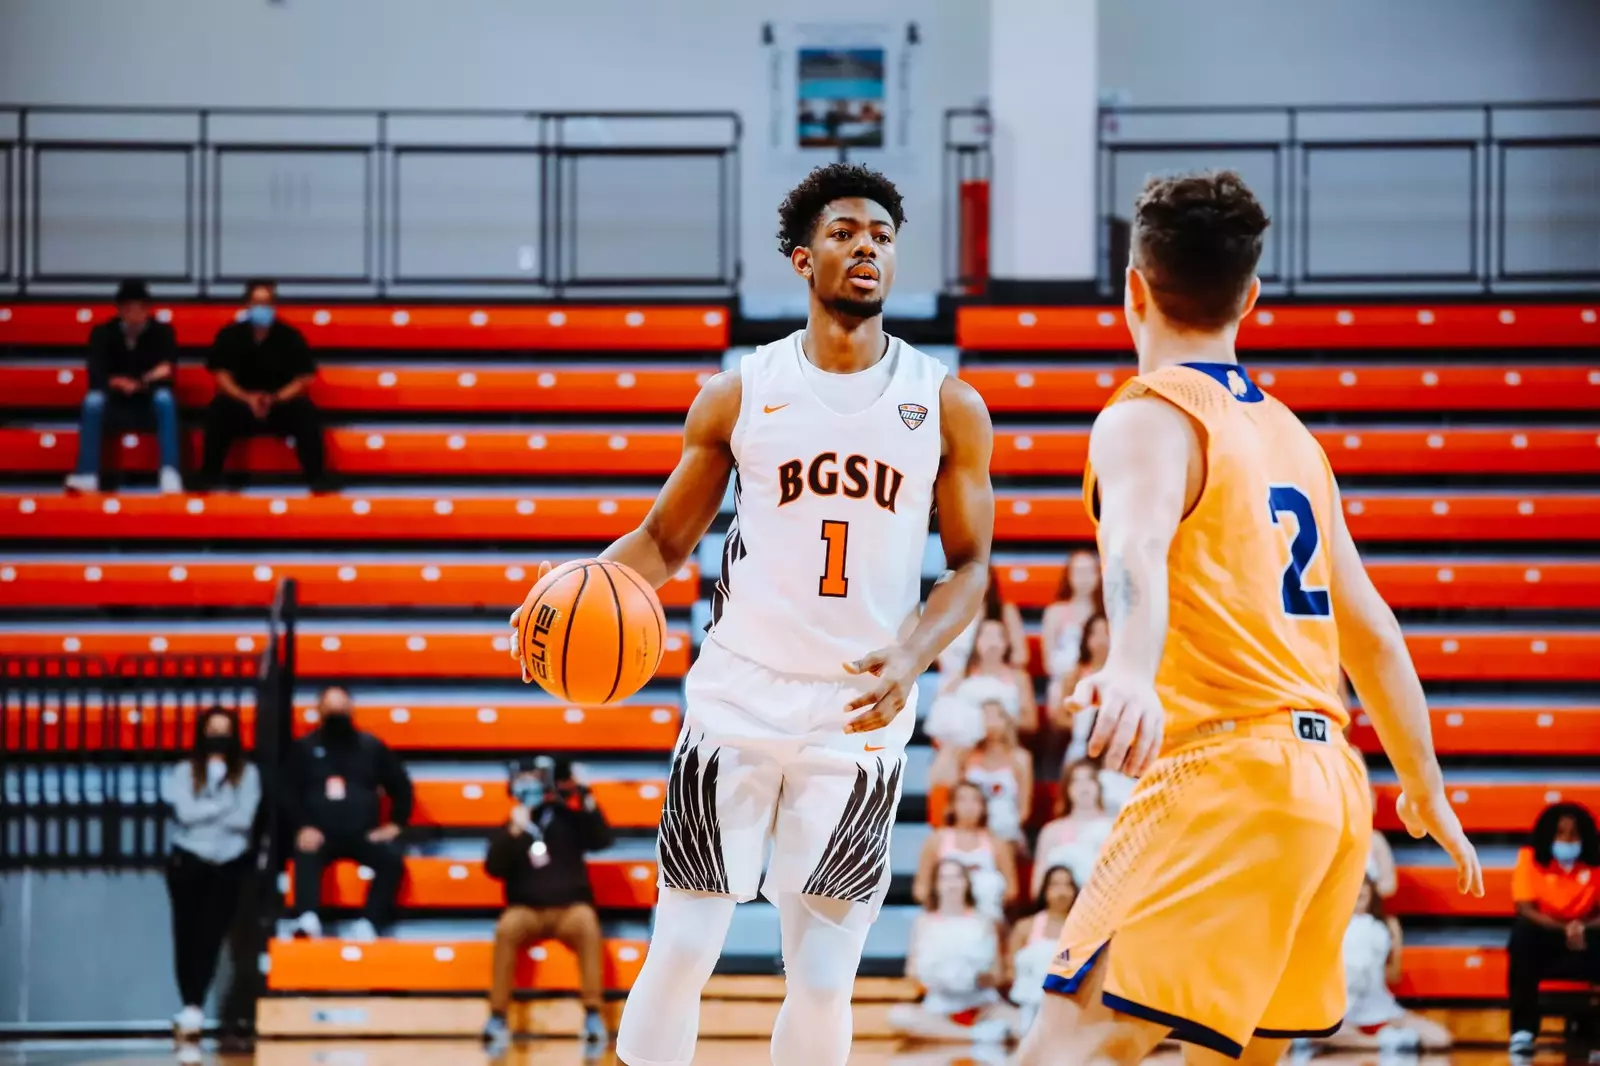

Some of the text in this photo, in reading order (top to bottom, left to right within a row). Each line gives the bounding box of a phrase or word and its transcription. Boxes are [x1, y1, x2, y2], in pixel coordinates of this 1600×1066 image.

[900, 410, 927, 421] MAC
[777, 452, 904, 514] BGSU
[819, 519, 849, 598] 1
[1268, 483, 1332, 619] 2
[531, 603, 557, 680] ELITE
